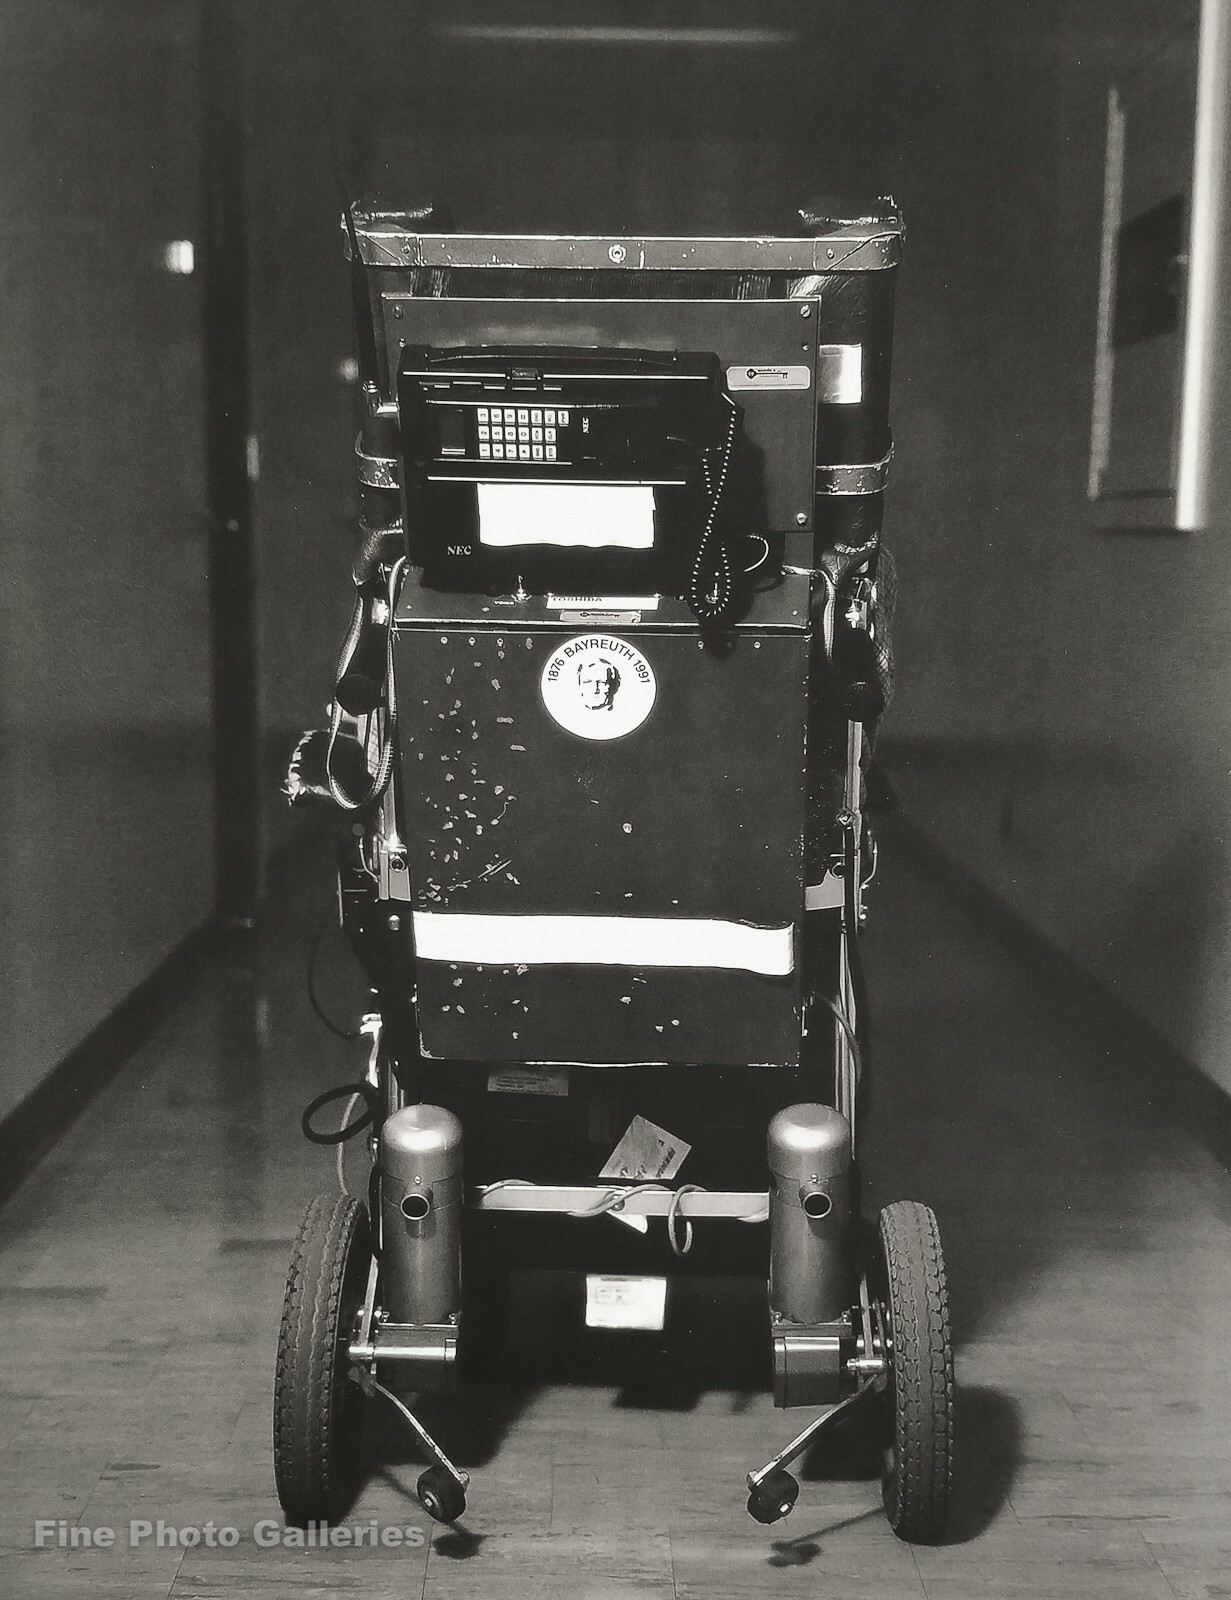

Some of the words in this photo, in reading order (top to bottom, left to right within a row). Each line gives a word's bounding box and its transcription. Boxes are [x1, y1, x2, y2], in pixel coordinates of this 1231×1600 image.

[447, 545, 472, 555] NEC
[547, 657, 565, 682] 1876
[563, 638, 636, 661] BAYREUTH
[633, 659, 651, 684] 1991
